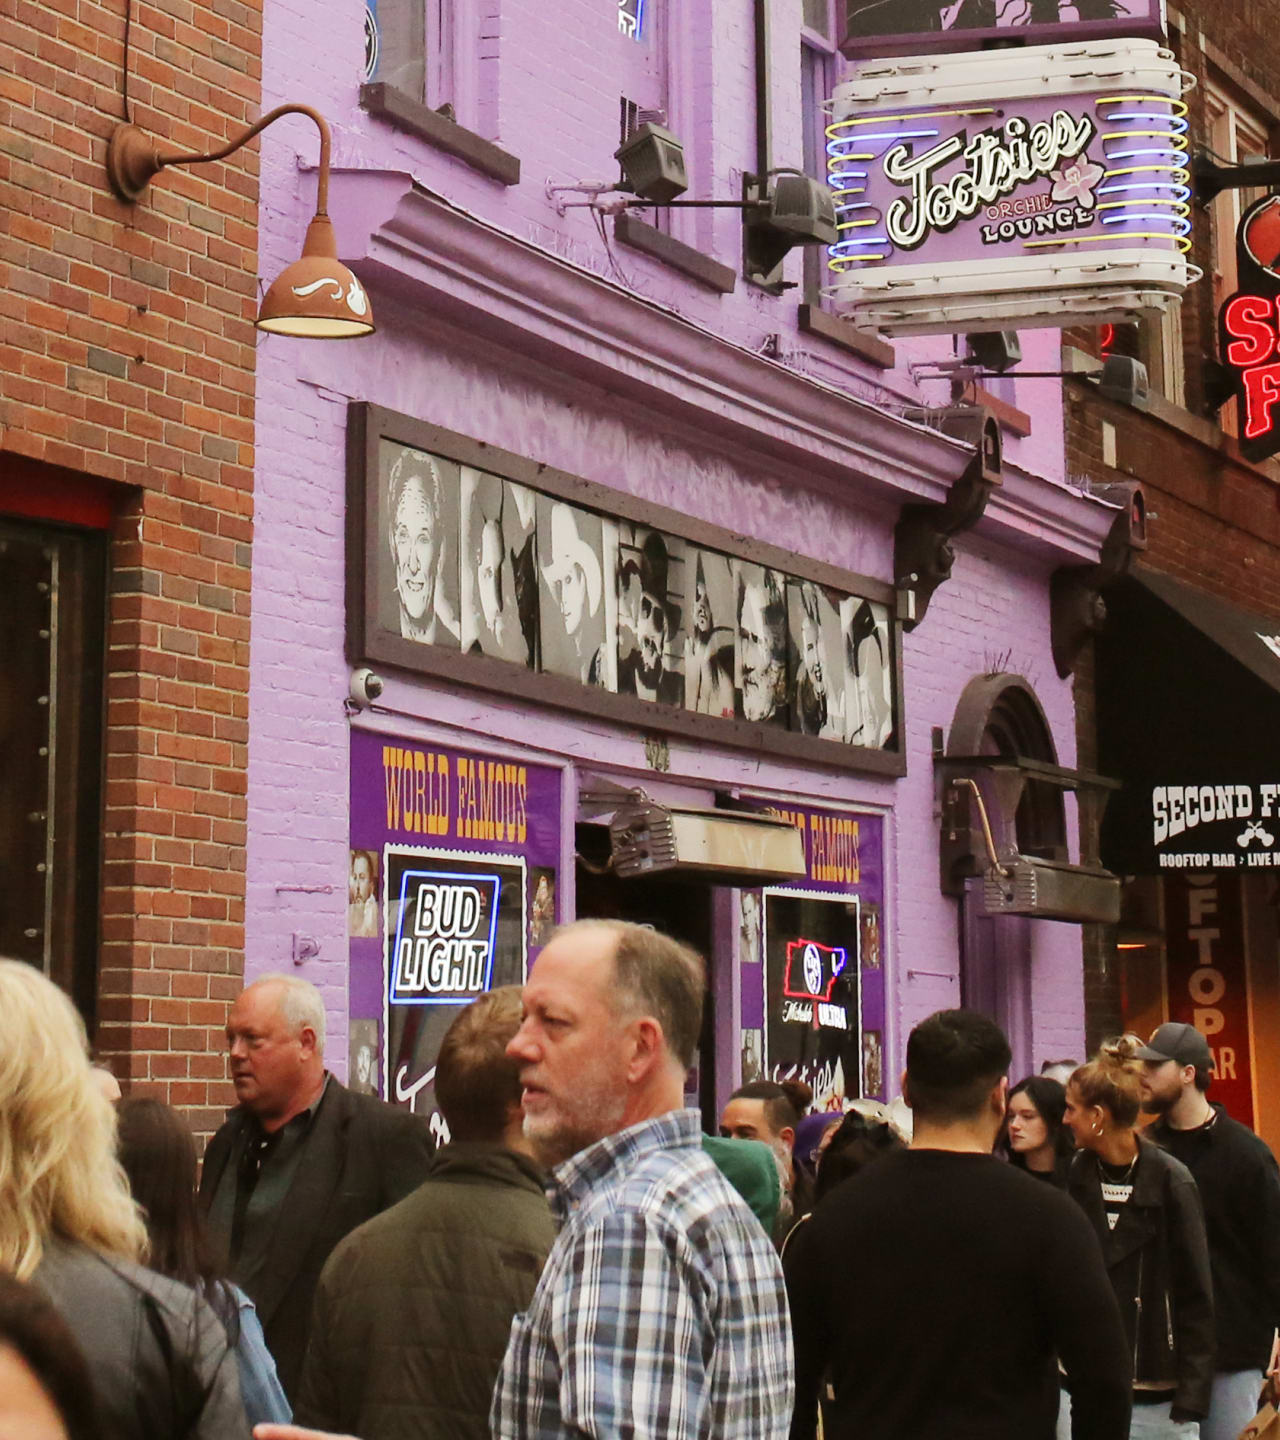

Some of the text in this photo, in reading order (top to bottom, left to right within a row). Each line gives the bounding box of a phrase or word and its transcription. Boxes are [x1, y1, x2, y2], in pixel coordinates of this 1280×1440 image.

[883, 109, 1098, 248] Tootsies
[982, 207, 1094, 244] LOUNGE
[381, 745, 528, 845] WORLD FAMOUS
[1153, 785, 1253, 846] SECOND
[1159, 853, 1210, 868] ROOFTOP
[1213, 853, 1236, 868] BAR
[1247, 853, 1271, 866] LIVE
[415, 884, 480, 939] BUD
[399, 938, 489, 993] LIGHT
